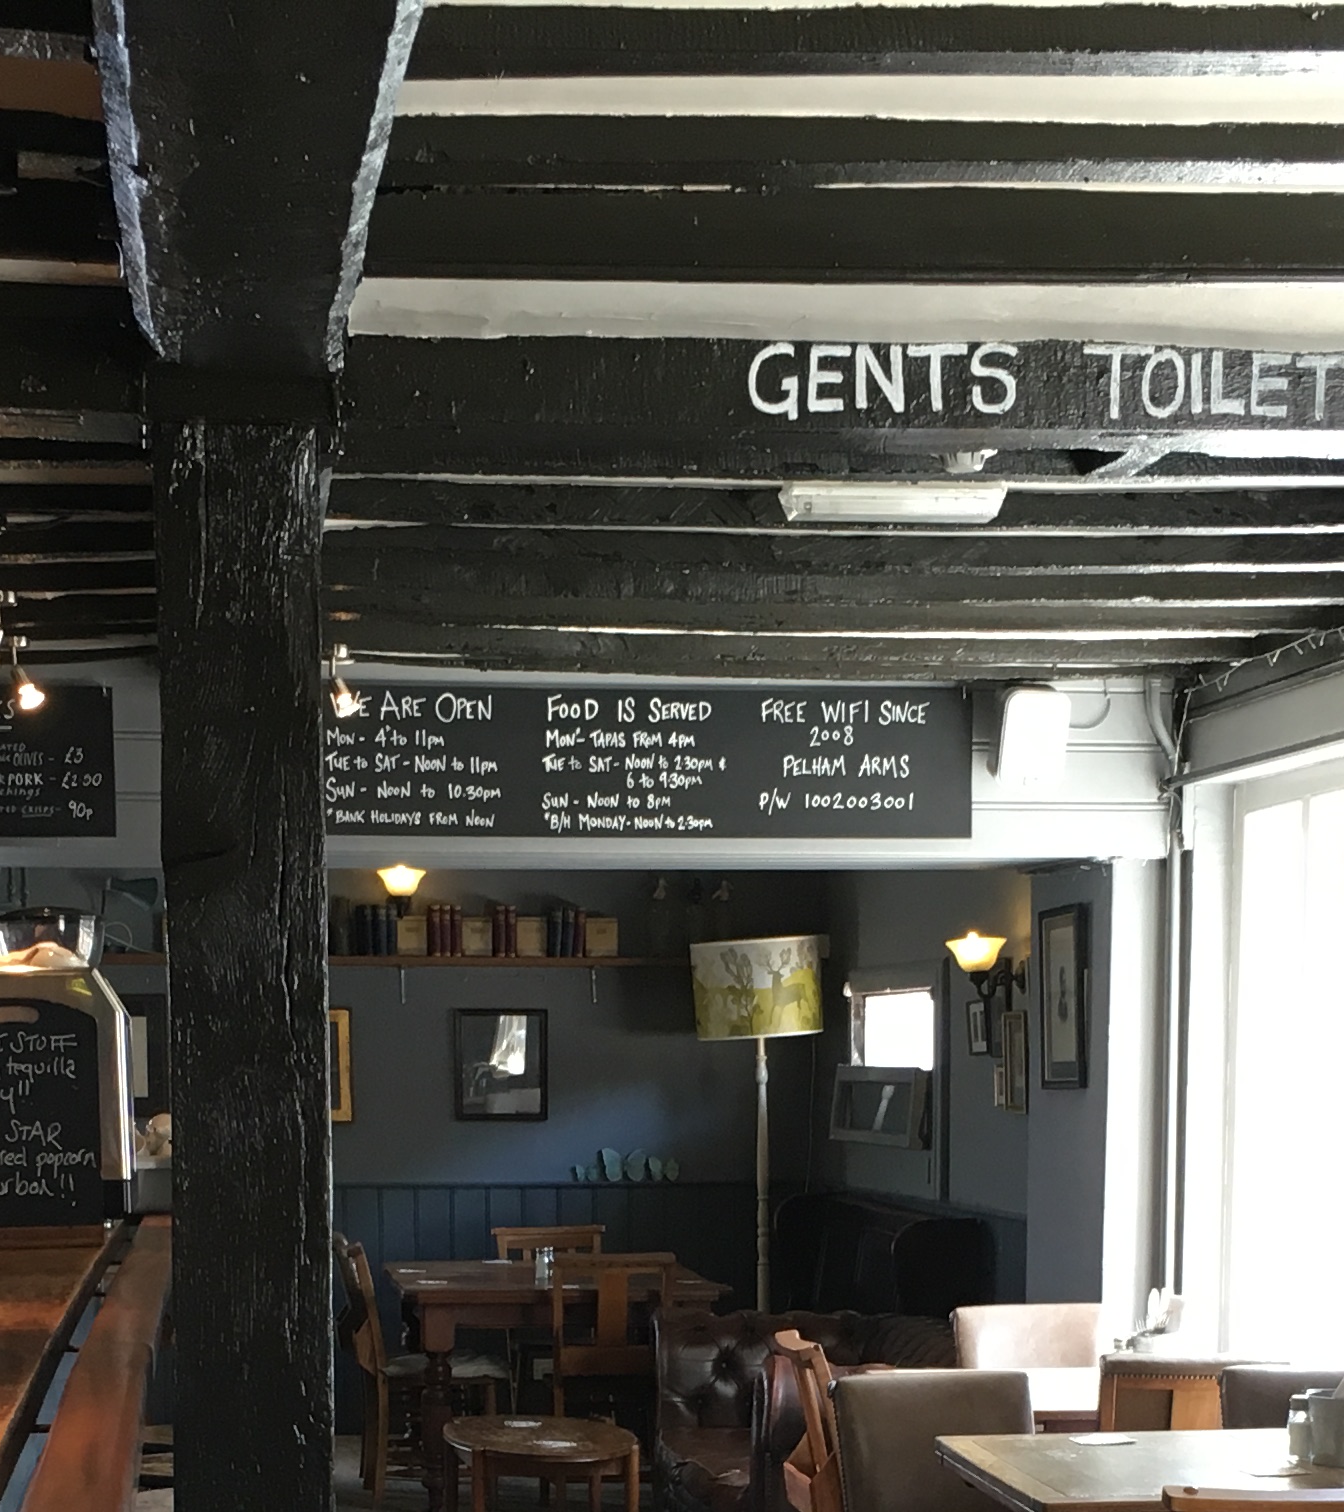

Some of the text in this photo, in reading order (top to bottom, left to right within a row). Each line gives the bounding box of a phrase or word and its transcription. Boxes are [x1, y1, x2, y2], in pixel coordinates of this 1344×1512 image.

[747, 341, 1019, 420] GENTS
[380, 690, 427, 720] ARE
[435, 692, 493, 723] OPEN
[547, 693, 712, 723] FOOD IS SERVED
[761, 697, 931, 725] FREE WIFI SINCE
[390, 729, 408, 747] to
[589, 729, 627, 748] TAPAS
[809, 725, 855, 748] 2008
[353, 755, 368, 771] to
[375, 752, 401, 773] SAT
[414, 754, 447, 773] NOON
[451, 756, 464, 771] to
[568, 755, 582, 771] to
[588, 755, 613, 773] SAT
[624, 753, 656, 770] NOON
[658, 754, 669, 770] to
[783, 753, 911, 779] PELHAM ARMS
[7, 772, 44, 787] PORK
[377, 780, 411, 799] NOON
[420, 783, 436, 799] to
[626, 771, 635, 789] 6
[639, 772, 655, 789] to
[67, 799, 94, 820] 90p
[587, 791, 620, 809] NOON
[626, 794, 640, 809] to
[758, 787, 915, 816] P/W 1002003001
[370, 809, 422, 826] HOLIDAYS
[429, 811, 459, 825] FROM
[465, 808, 496, 828] NOON
[634, 813, 664, 831] NOON
[664, 816, 676, 830] to
[9, 1030, 78, 1054] STUFF
[4, 1119, 64, 1151] STAR
[35, 1148, 97, 1179] popcorn
